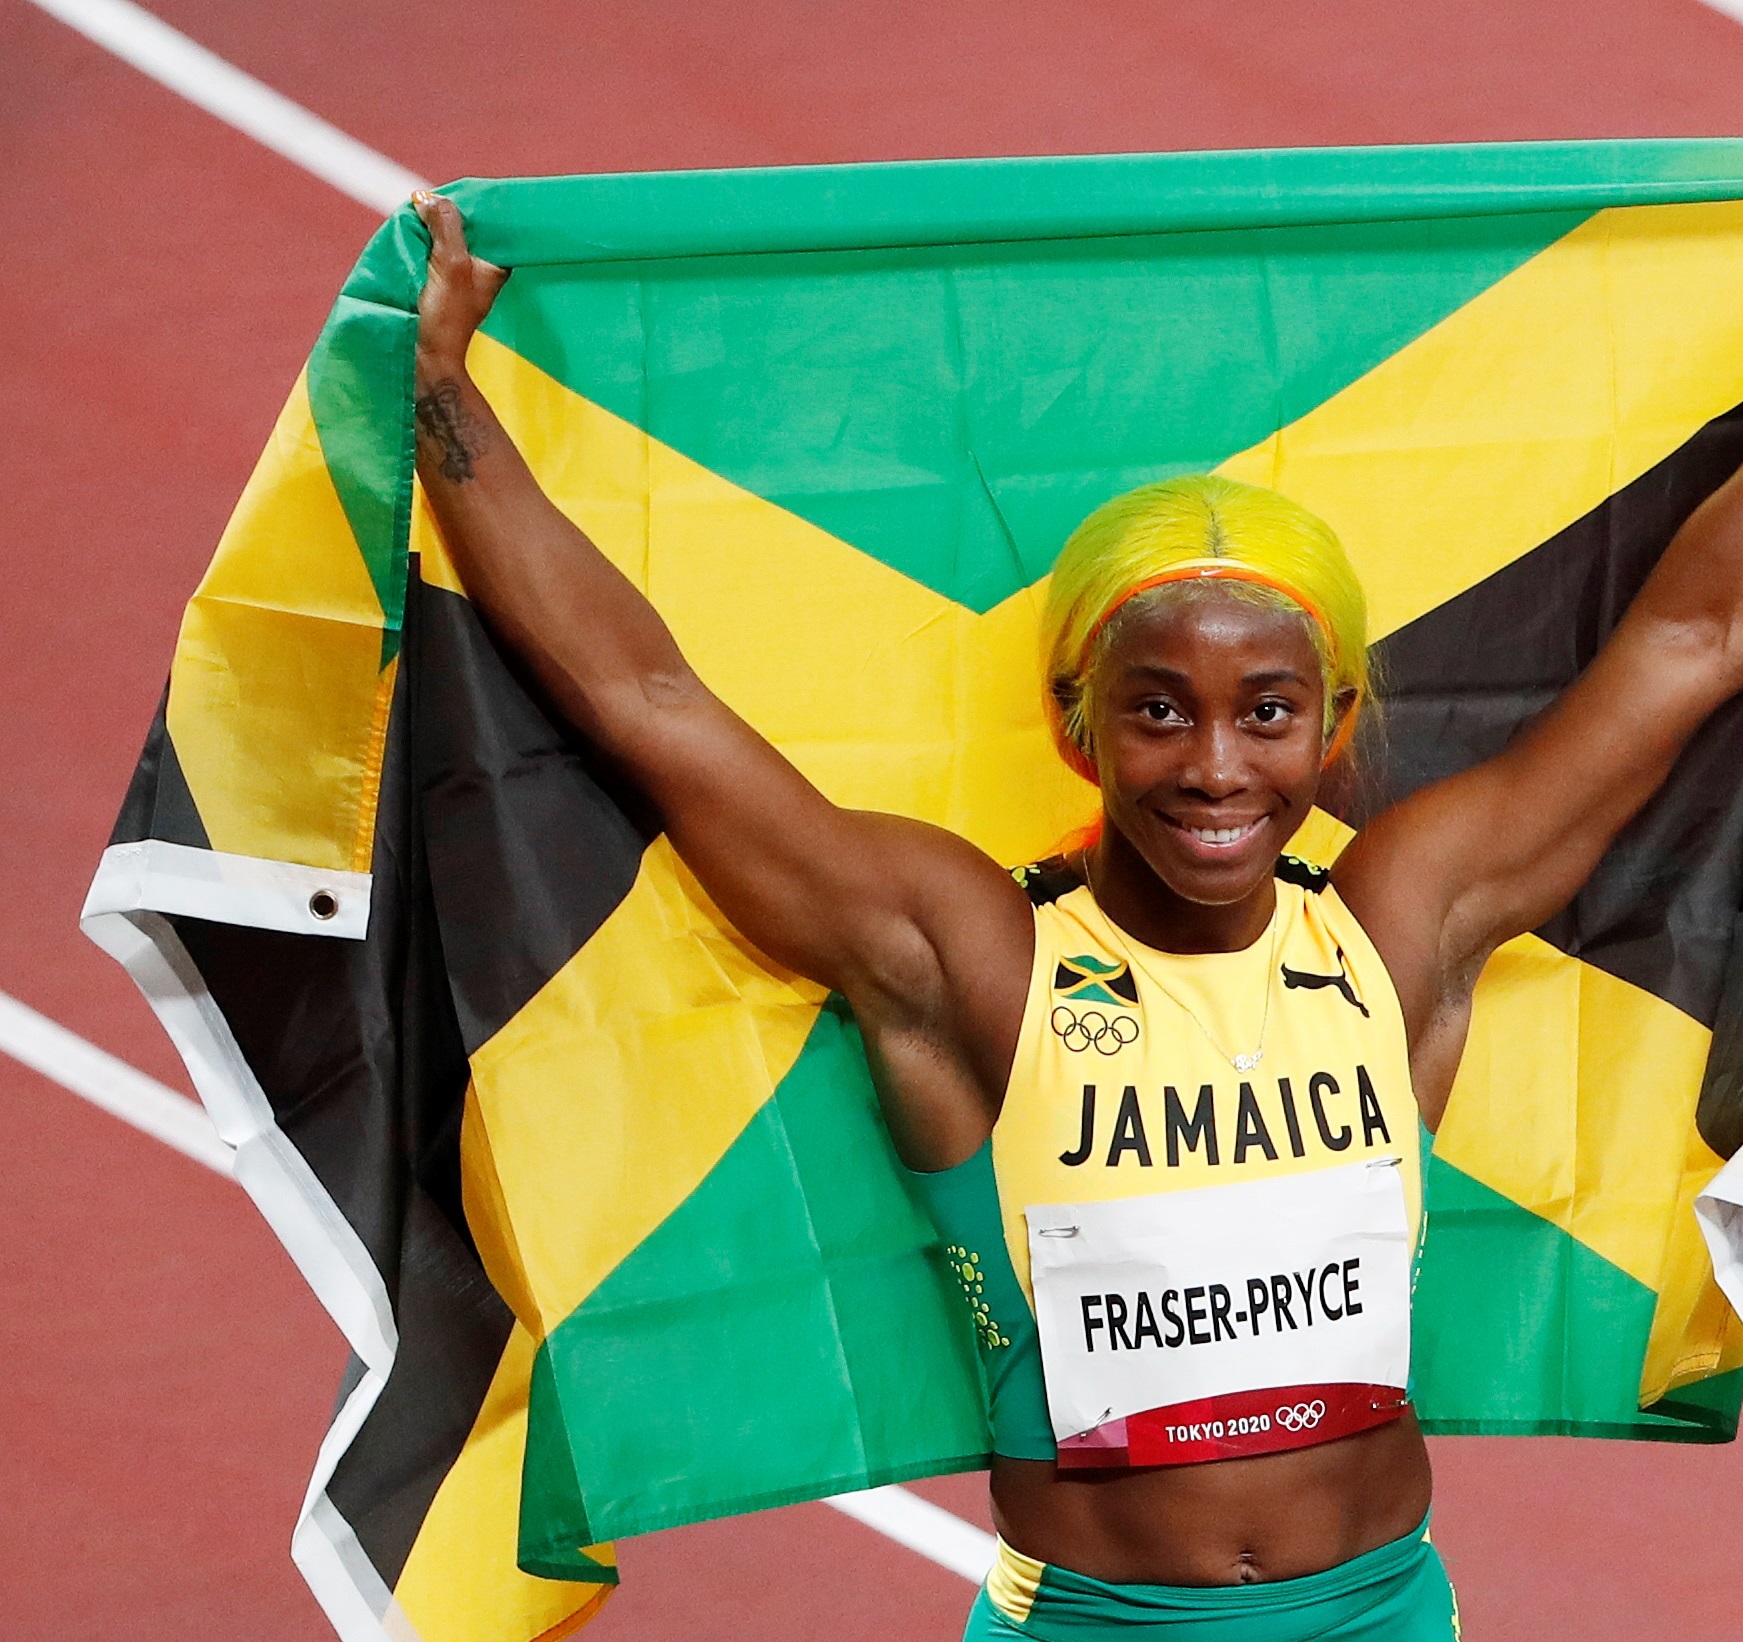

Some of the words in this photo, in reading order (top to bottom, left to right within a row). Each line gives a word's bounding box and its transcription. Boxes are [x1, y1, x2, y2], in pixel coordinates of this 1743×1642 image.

[1057, 1063, 1393, 1169] JAMAICA
[1079, 1256, 1364, 1354] FRASER-PRYCE
[1164, 1420, 1225, 1444] TOKYO
[1226, 1414, 1271, 1437] 2020
